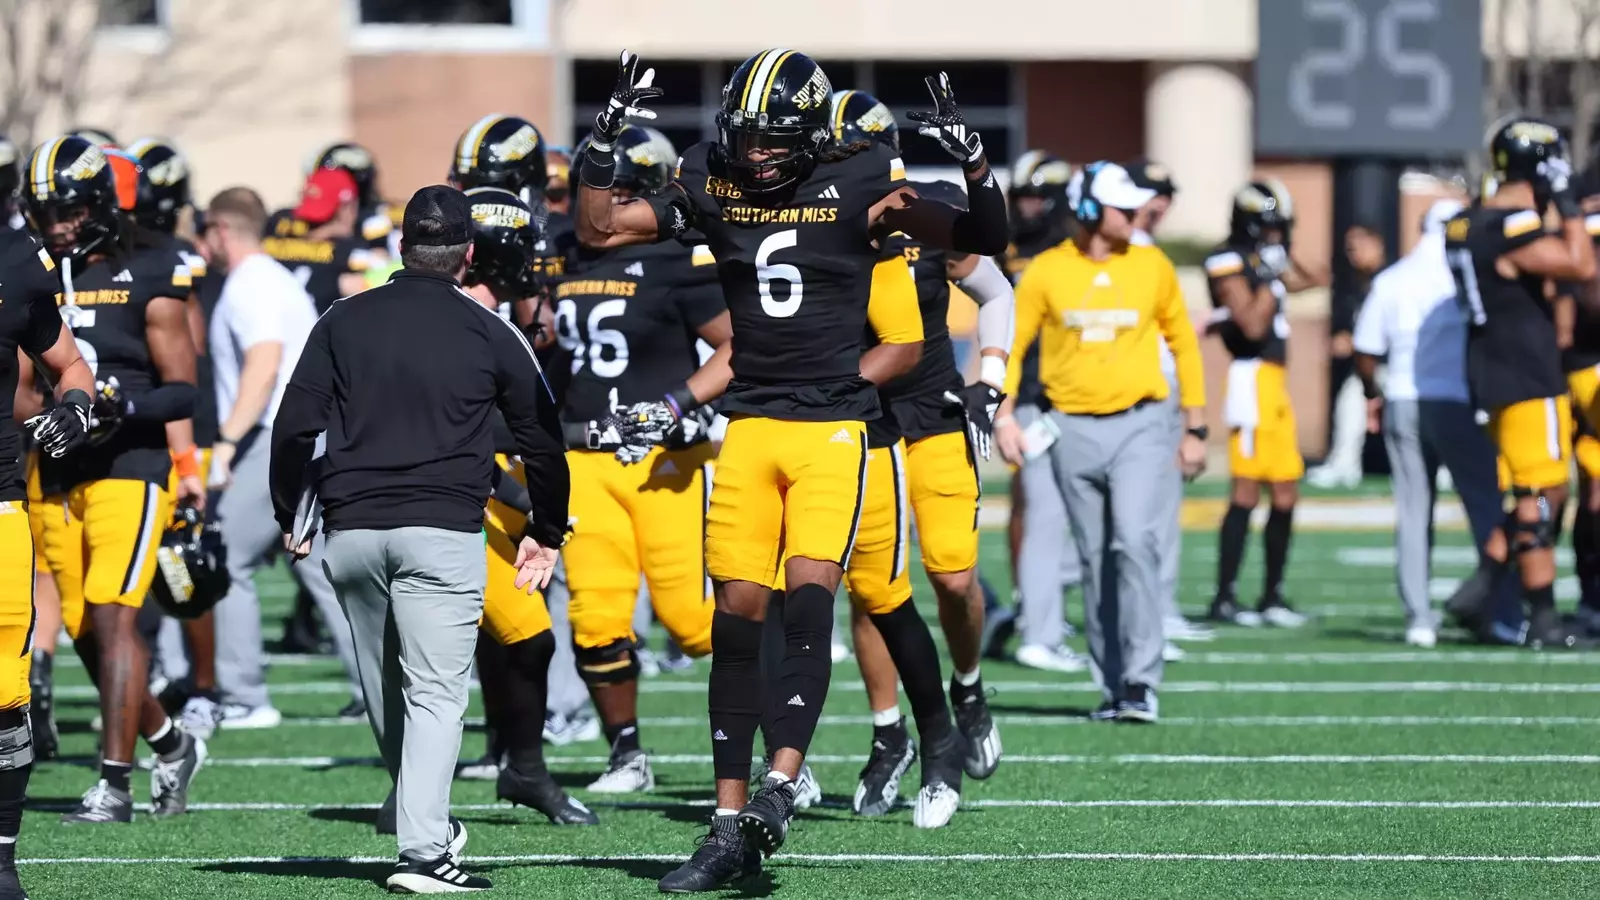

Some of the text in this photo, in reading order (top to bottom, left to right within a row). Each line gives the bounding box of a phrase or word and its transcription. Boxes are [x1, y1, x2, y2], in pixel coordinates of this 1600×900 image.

[1288, 0, 1453, 130] 25
[471, 203, 531, 222] SOUTHERN
[722, 206, 838, 223] SOUTHERN MISS
[604, 280, 638, 297] MISS
[754, 229, 804, 318] 6
[553, 299, 630, 378] 96
